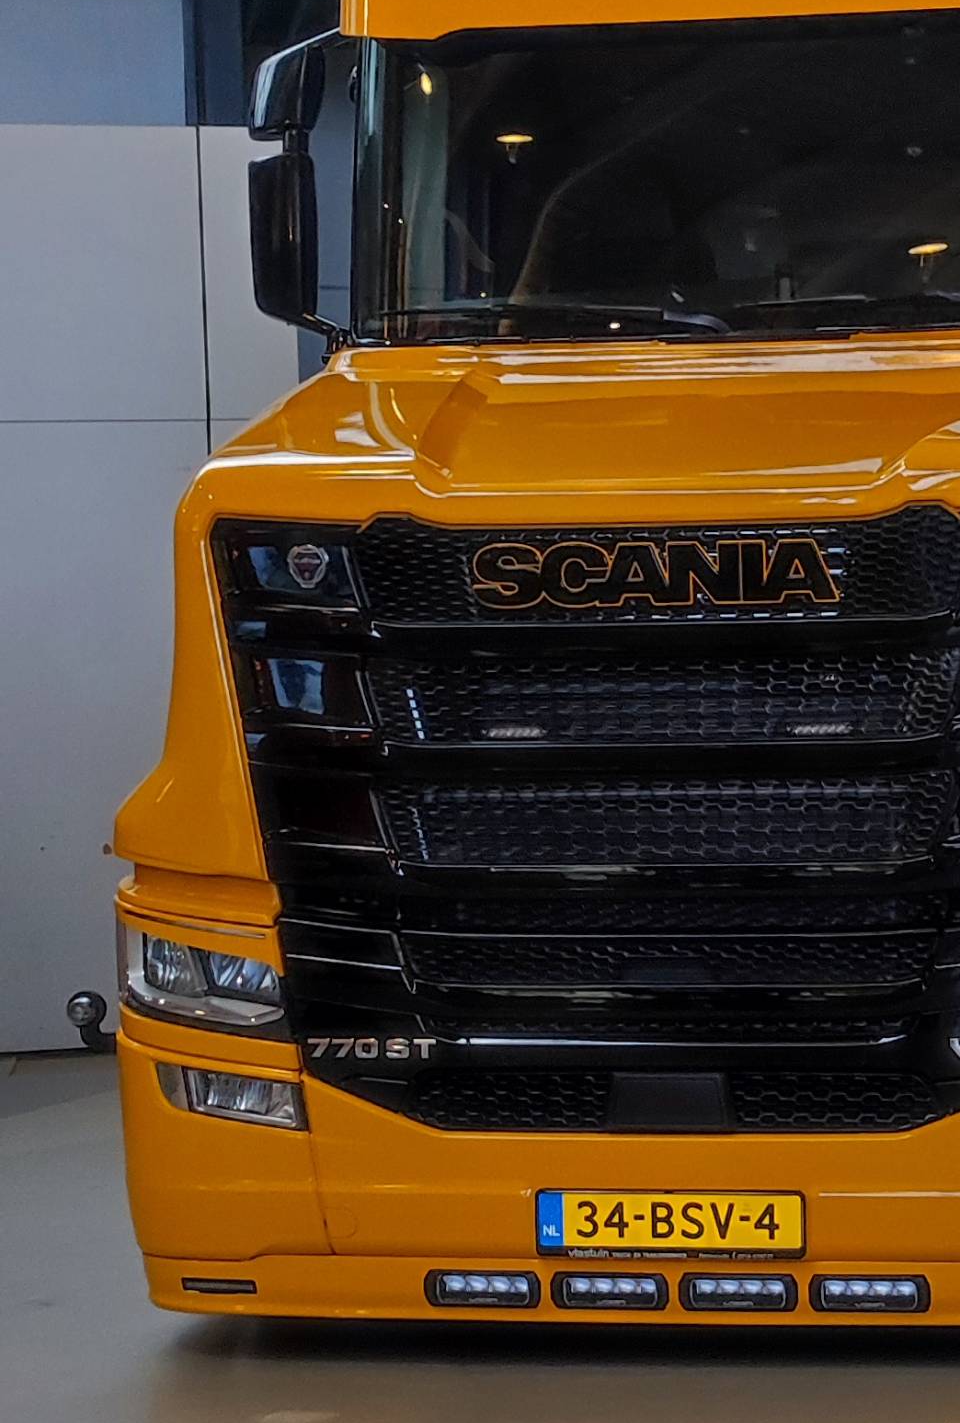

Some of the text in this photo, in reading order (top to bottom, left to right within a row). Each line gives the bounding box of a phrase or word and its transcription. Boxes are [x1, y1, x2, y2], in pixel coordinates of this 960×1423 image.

[472, 539, 841, 609] SCANIA
[307, 1037, 437, 1059] 770 ST
[543, 1224, 561, 1237] NL
[576, 1200, 780, 1240] 34-BSV-4
